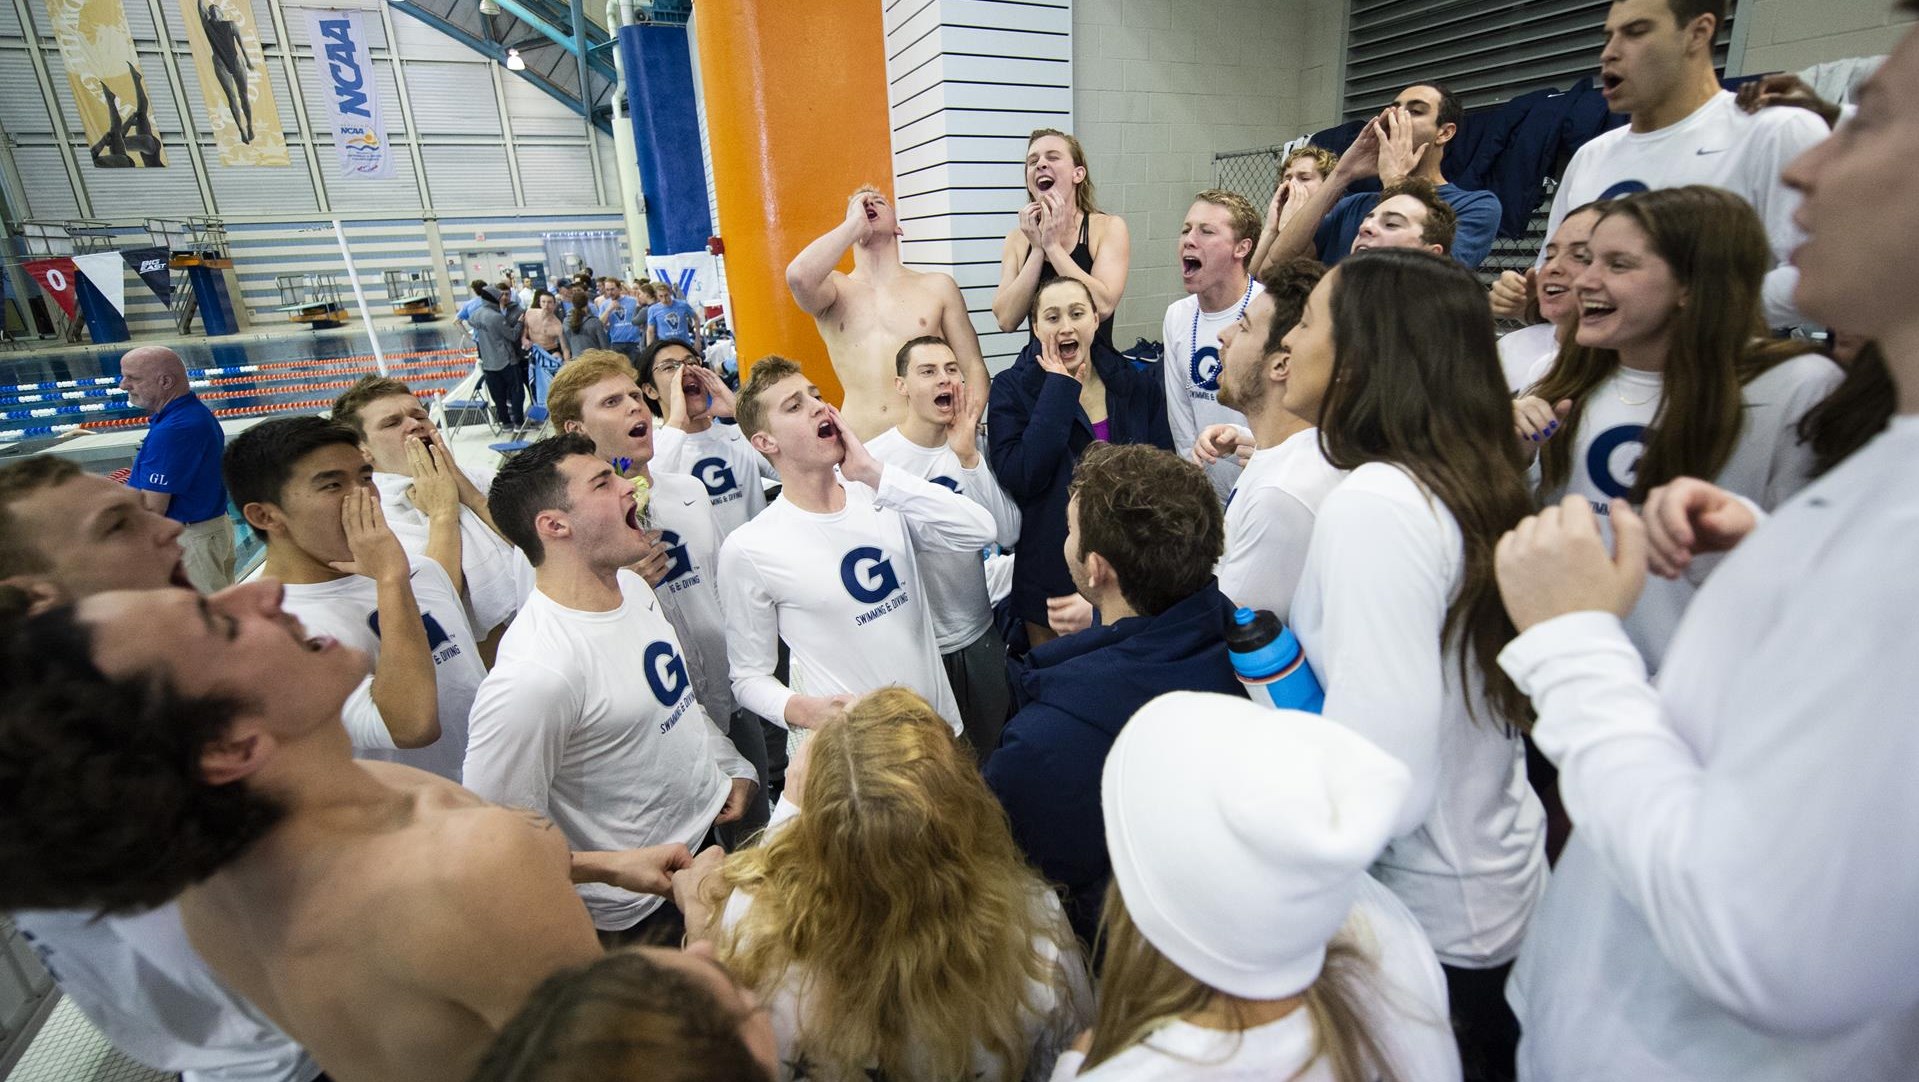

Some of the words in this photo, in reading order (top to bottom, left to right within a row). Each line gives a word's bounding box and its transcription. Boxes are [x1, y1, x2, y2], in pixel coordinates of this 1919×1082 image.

[319, 19, 371, 118] NCAA
[1191, 346, 1223, 391] G
[150, 473, 168, 485] GL
[691, 457, 737, 496] G
[682, 574, 700, 589] DIVING
[840, 546, 900, 604] G
[855, 604, 887, 627] SWIMMING
[885, 602, 893, 612] &
[891, 592, 909, 609] DIVING
[440, 644, 461, 661] DIVING
[644, 640, 690, 707] G
[660, 704, 682, 735] SWIMMING
